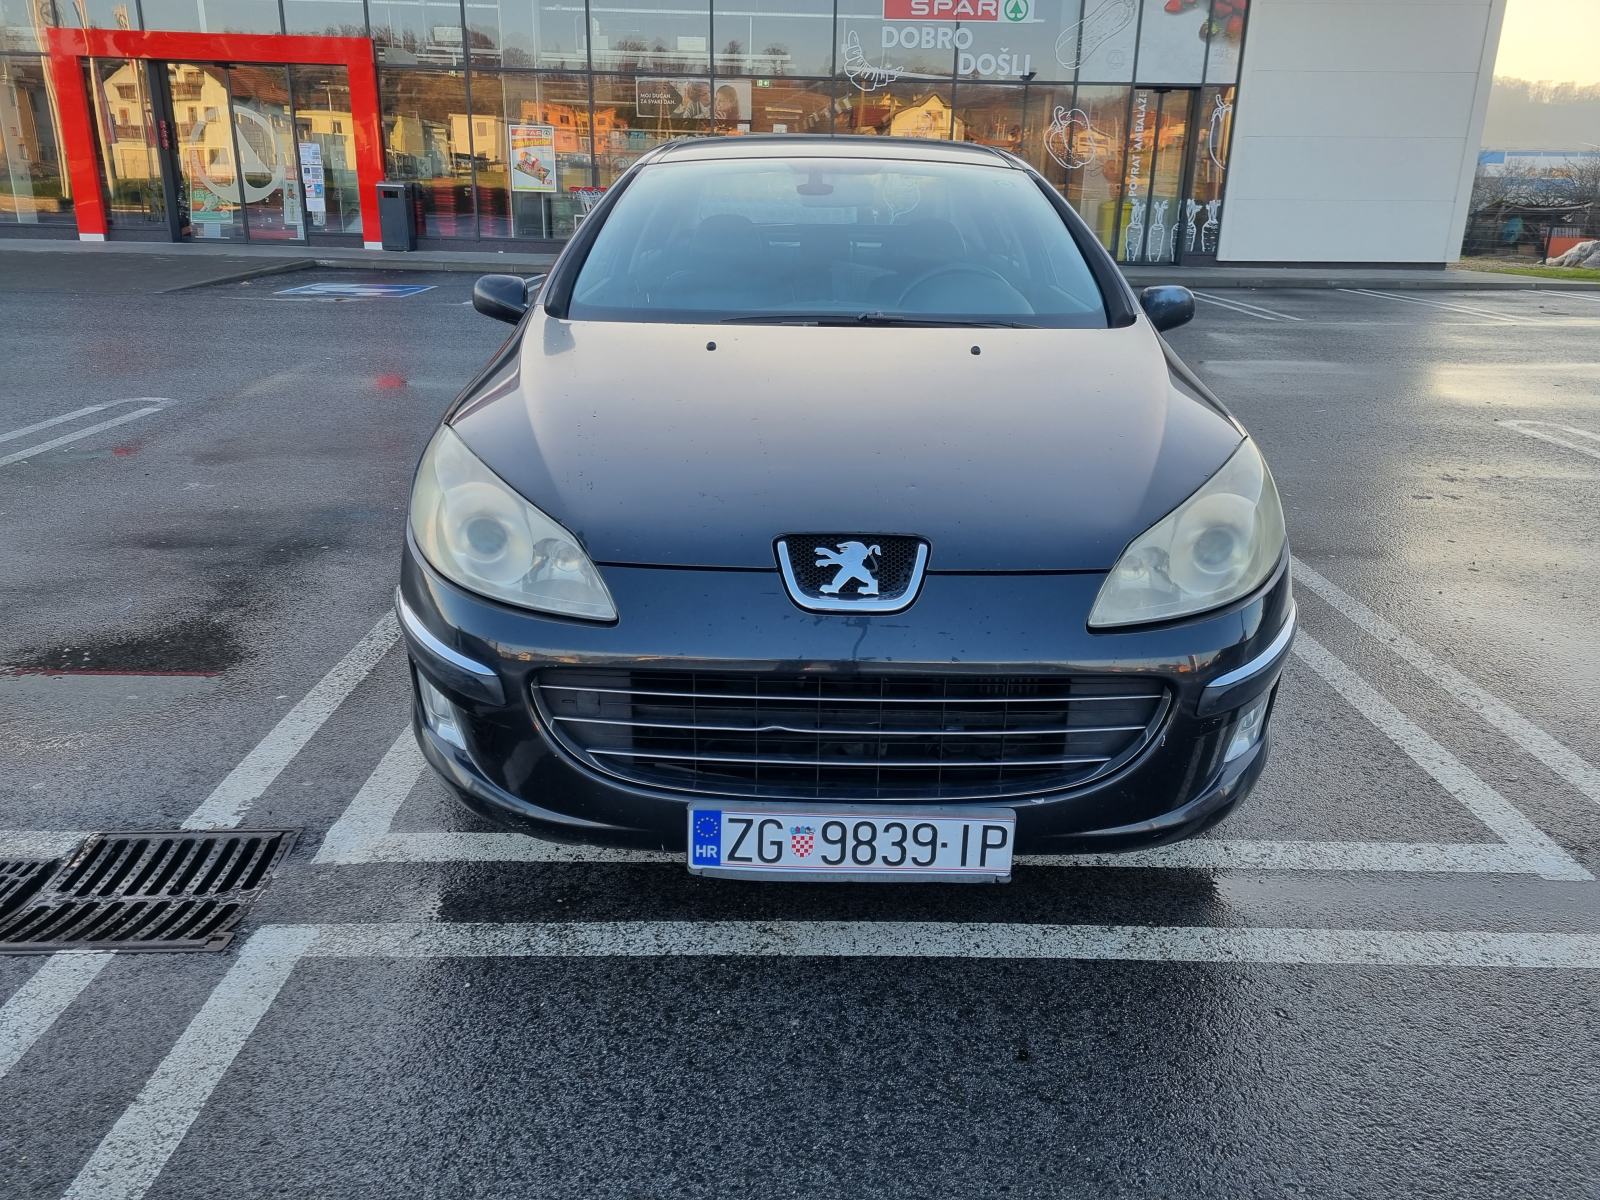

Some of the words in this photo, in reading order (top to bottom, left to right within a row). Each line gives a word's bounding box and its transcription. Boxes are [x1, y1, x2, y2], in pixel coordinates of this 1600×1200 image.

[911, 0, 997, 16] SPAR
[881, 26, 974, 50] DOBRO
[958, 47, 1031, 76] DOŠLI
[1128, 154, 1140, 197] POVRAT
[695, 844, 718, 859] HR
[727, 817, 784, 864] ZG
